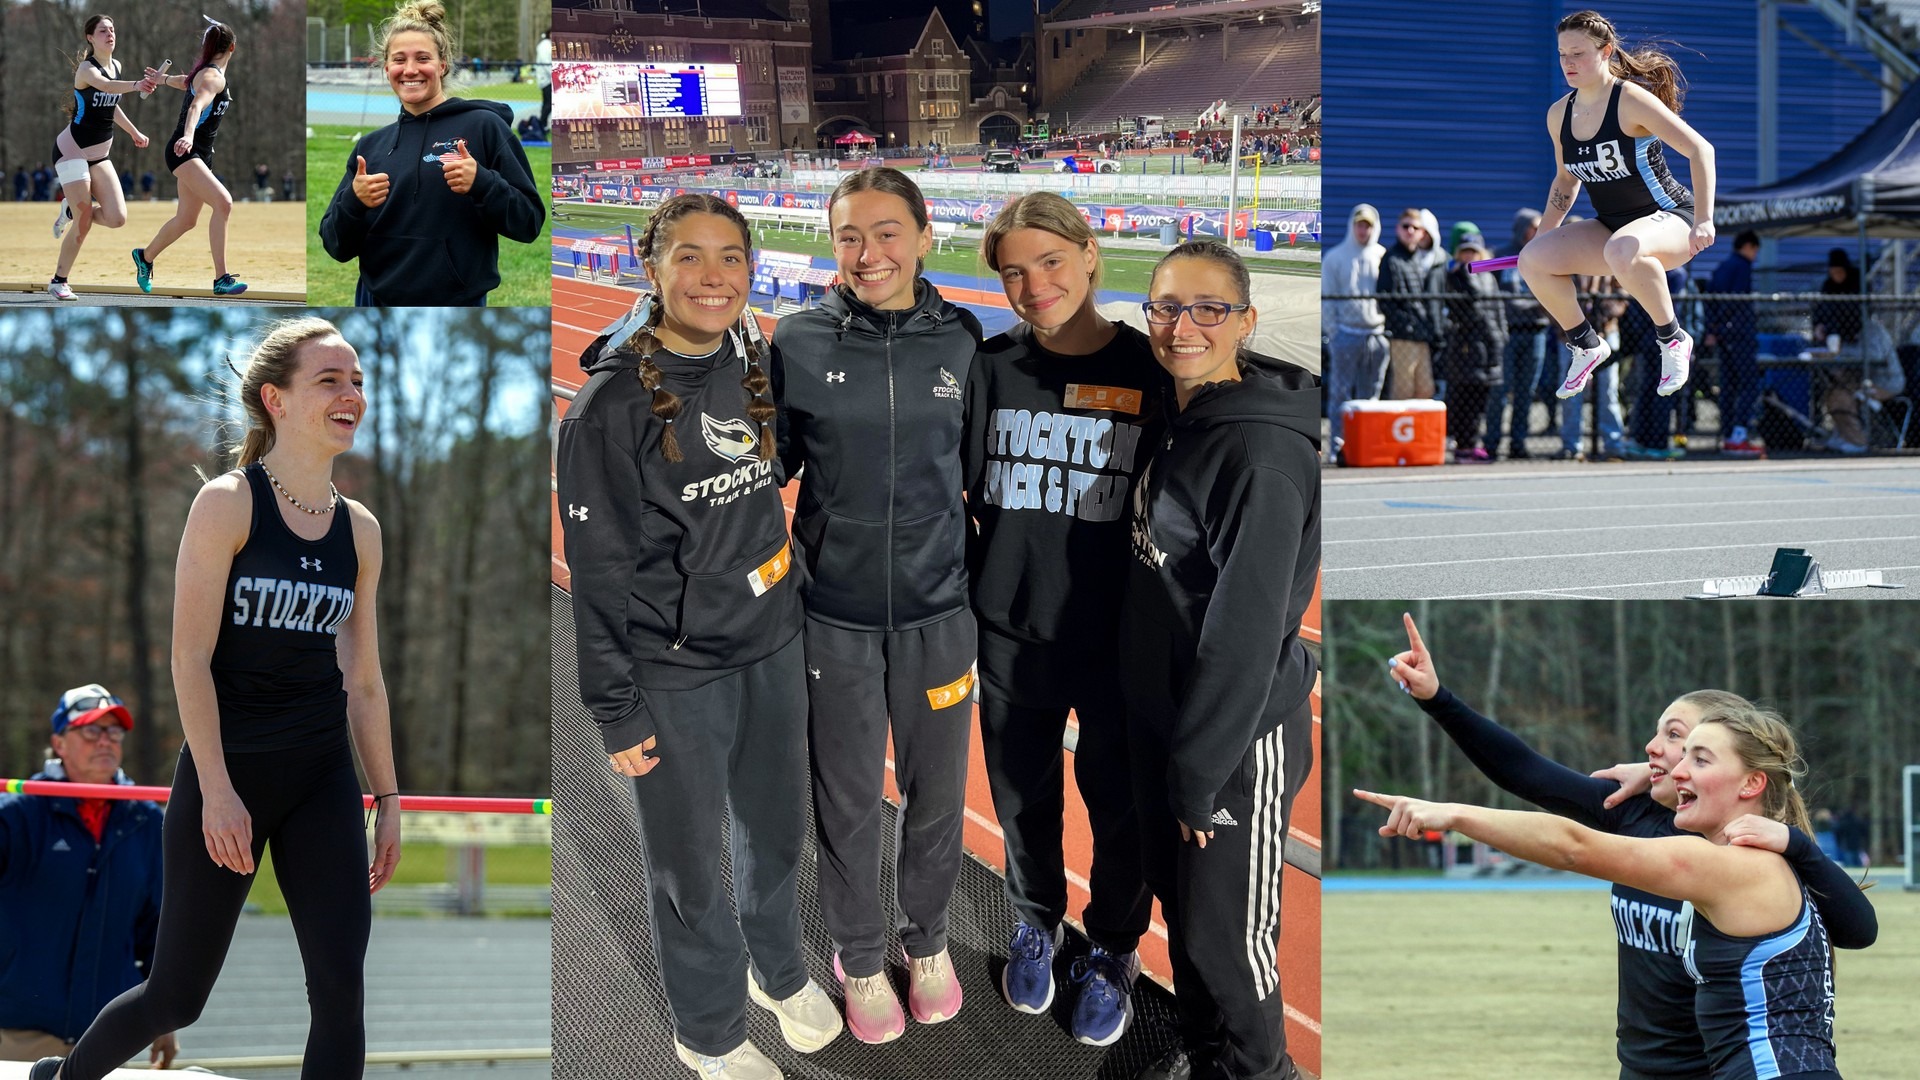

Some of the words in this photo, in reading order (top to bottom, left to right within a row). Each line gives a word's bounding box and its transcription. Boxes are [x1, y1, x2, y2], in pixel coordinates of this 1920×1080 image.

[92, 91, 122, 107] STOCKT
[1564, 155, 1632, 182] TOCKTON
[1601, 143, 1619, 171] 3
[602, 188, 618, 196] TOYOTA
[737, 195, 760, 204] TOYOTA
[795, 198, 820, 208] TOYOTA
[935, 206, 966, 216] TOYOTA
[1127, 214, 1171, 226] TOYOT
[1766, 195, 1846, 220] UNIVERSITY
[987, 408, 1142, 473] STOCKTON
[1392, 416, 1415, 444] G
[708, 490, 740, 507] TRACK
[743, 486, 751, 496] &
[754, 476, 772, 492] FIELD
[984, 460, 1044, 510] RACK
[1045, 466, 1063, 513] &
[1066, 469, 1129, 522] FIELD
[233, 576, 354, 635] STOCKTO
[1611, 894, 1684, 956] TOCKTO
